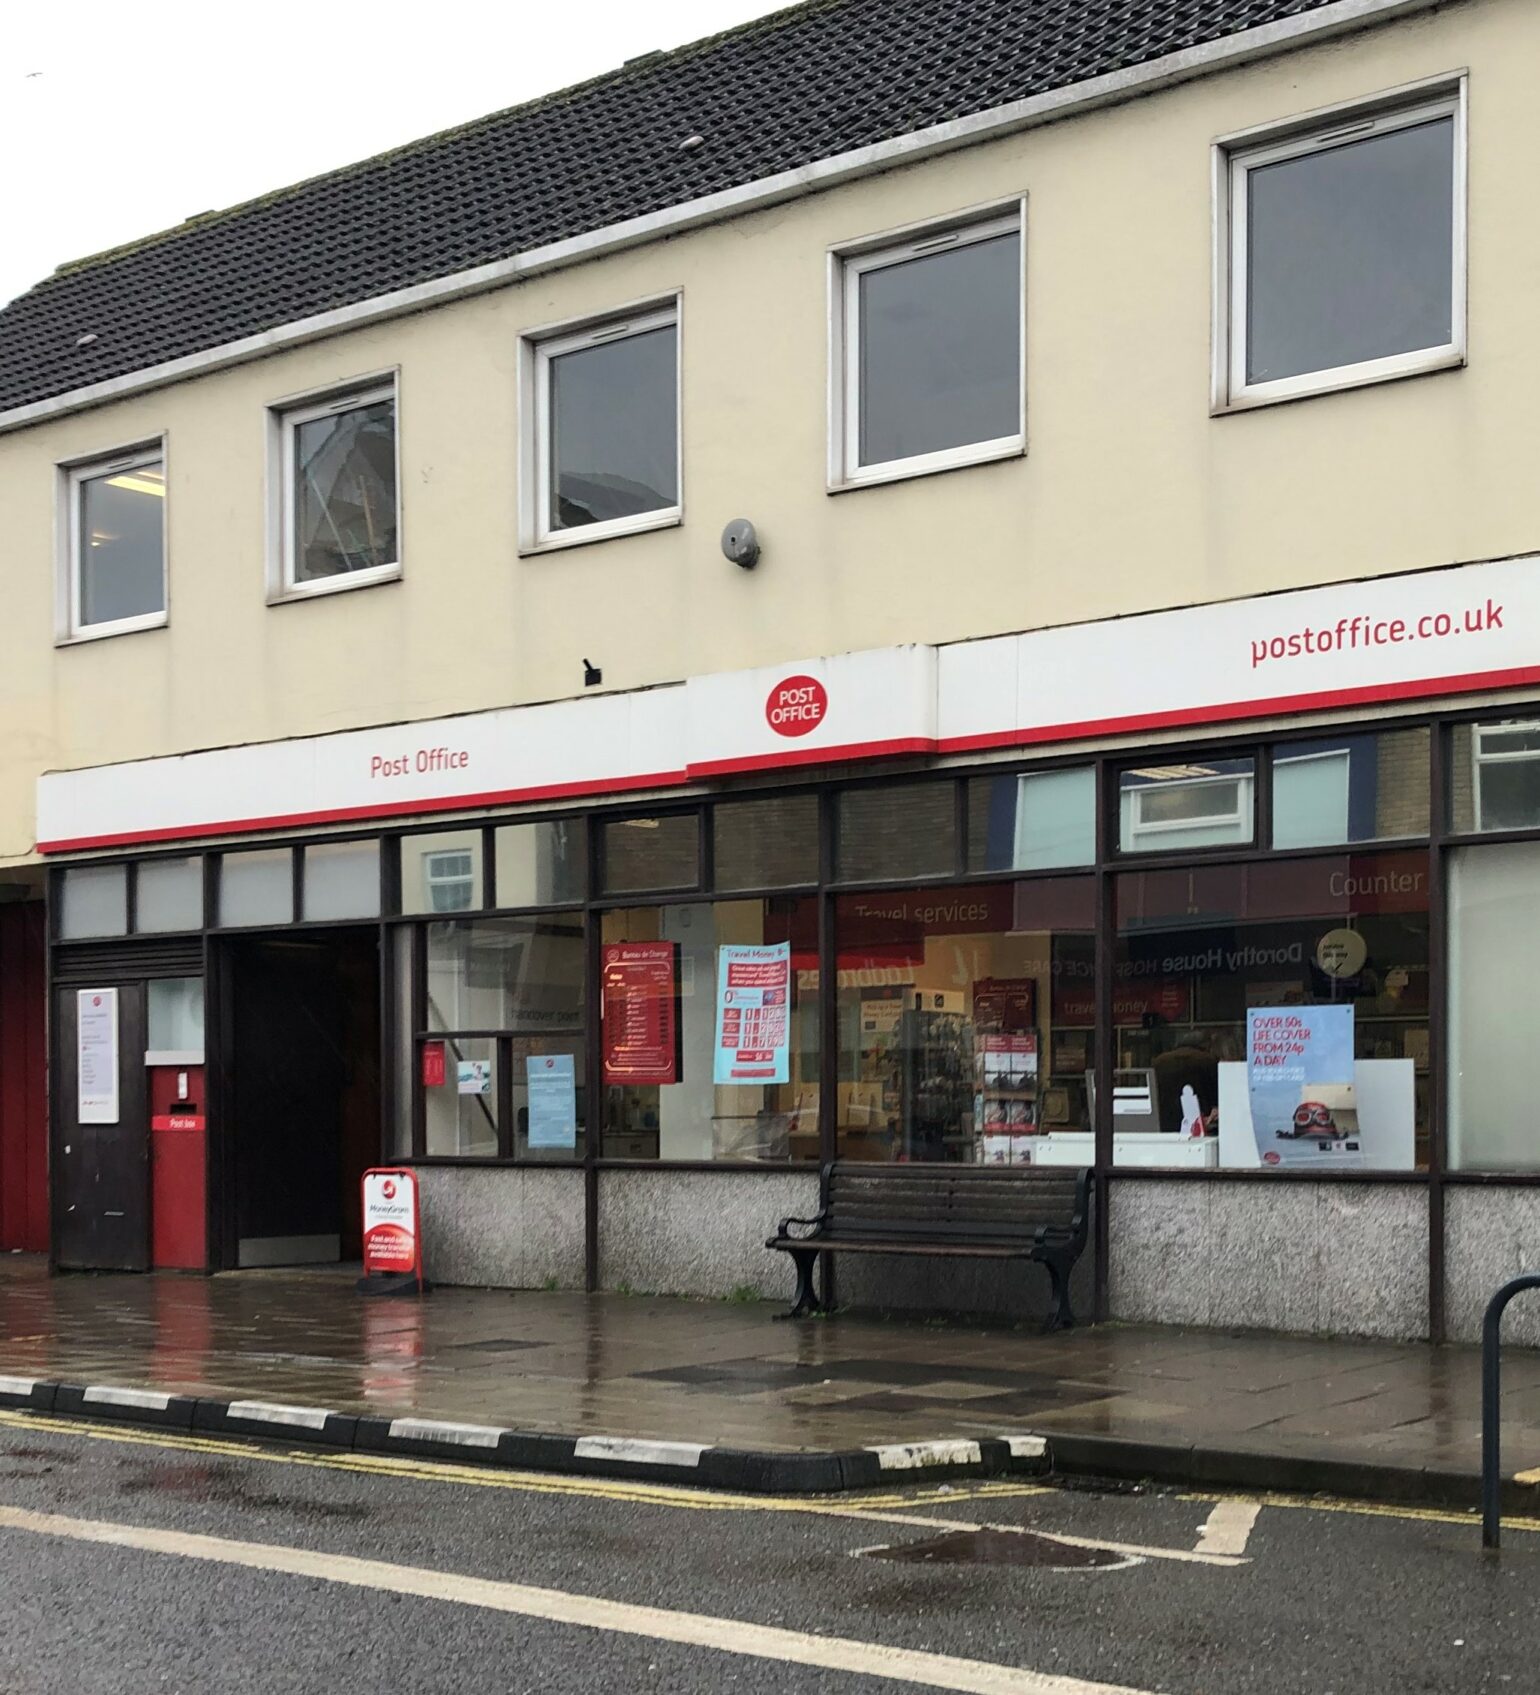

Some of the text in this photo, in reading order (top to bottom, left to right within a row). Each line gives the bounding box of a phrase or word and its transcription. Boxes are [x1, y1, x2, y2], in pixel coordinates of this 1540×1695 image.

[1251, 598, 1504, 669] postoffice.co.uk
[779, 686, 816, 706] POST
[771, 703, 821, 724] OFFICE
[371, 747, 469, 778] Post Office
[1329, 870, 1425, 897] Counter
[914, 899, 988, 923] services
[1064, 1000, 1148, 1015] trave oney
[1253, 1017, 1282, 1028] OVER
[1253, 1029, 1312, 1041] LIFE COVER
[1253, 1043, 1283, 1054] FROM
[1253, 1055, 1287, 1066] A DAY
